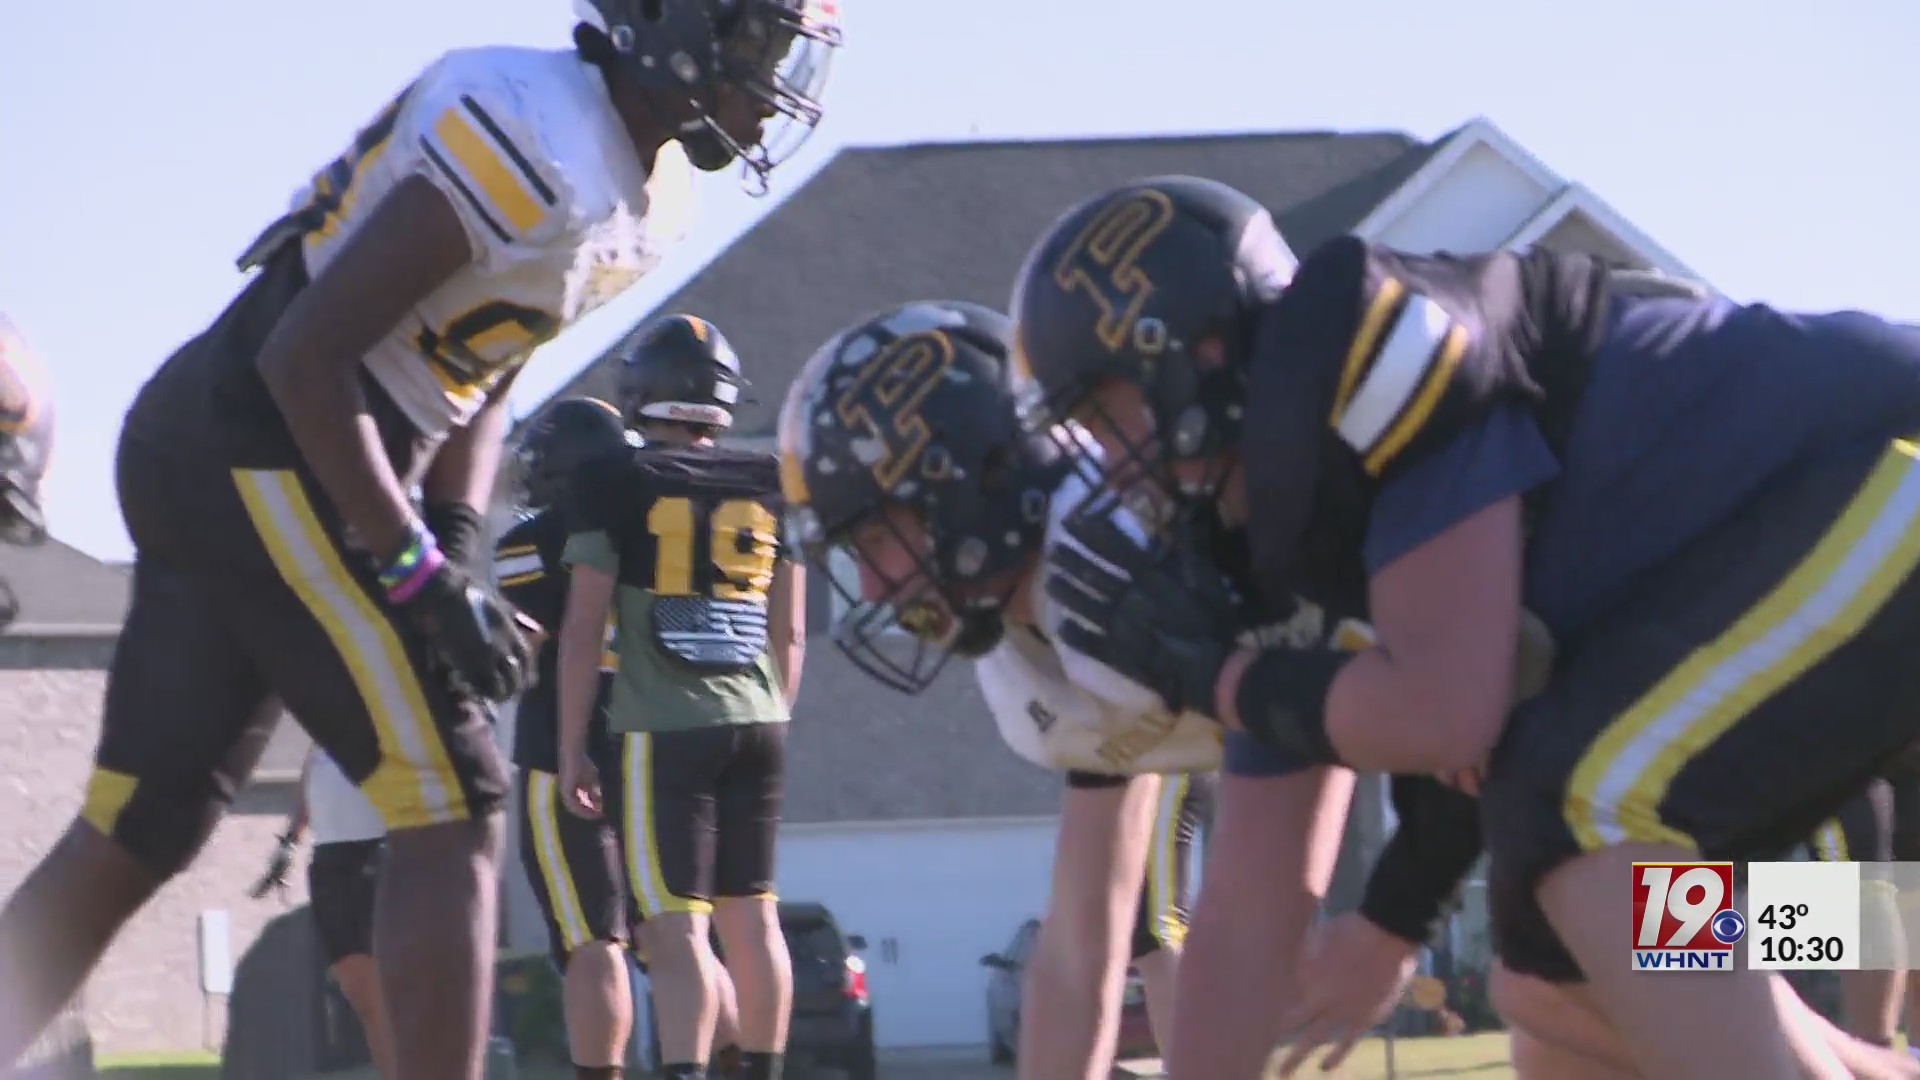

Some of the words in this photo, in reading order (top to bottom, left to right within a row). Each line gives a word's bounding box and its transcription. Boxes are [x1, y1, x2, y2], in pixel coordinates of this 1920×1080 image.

[1055, 188, 1174, 350] P
[837, 330, 953, 489] P
[646, 496, 778, 600] 19
